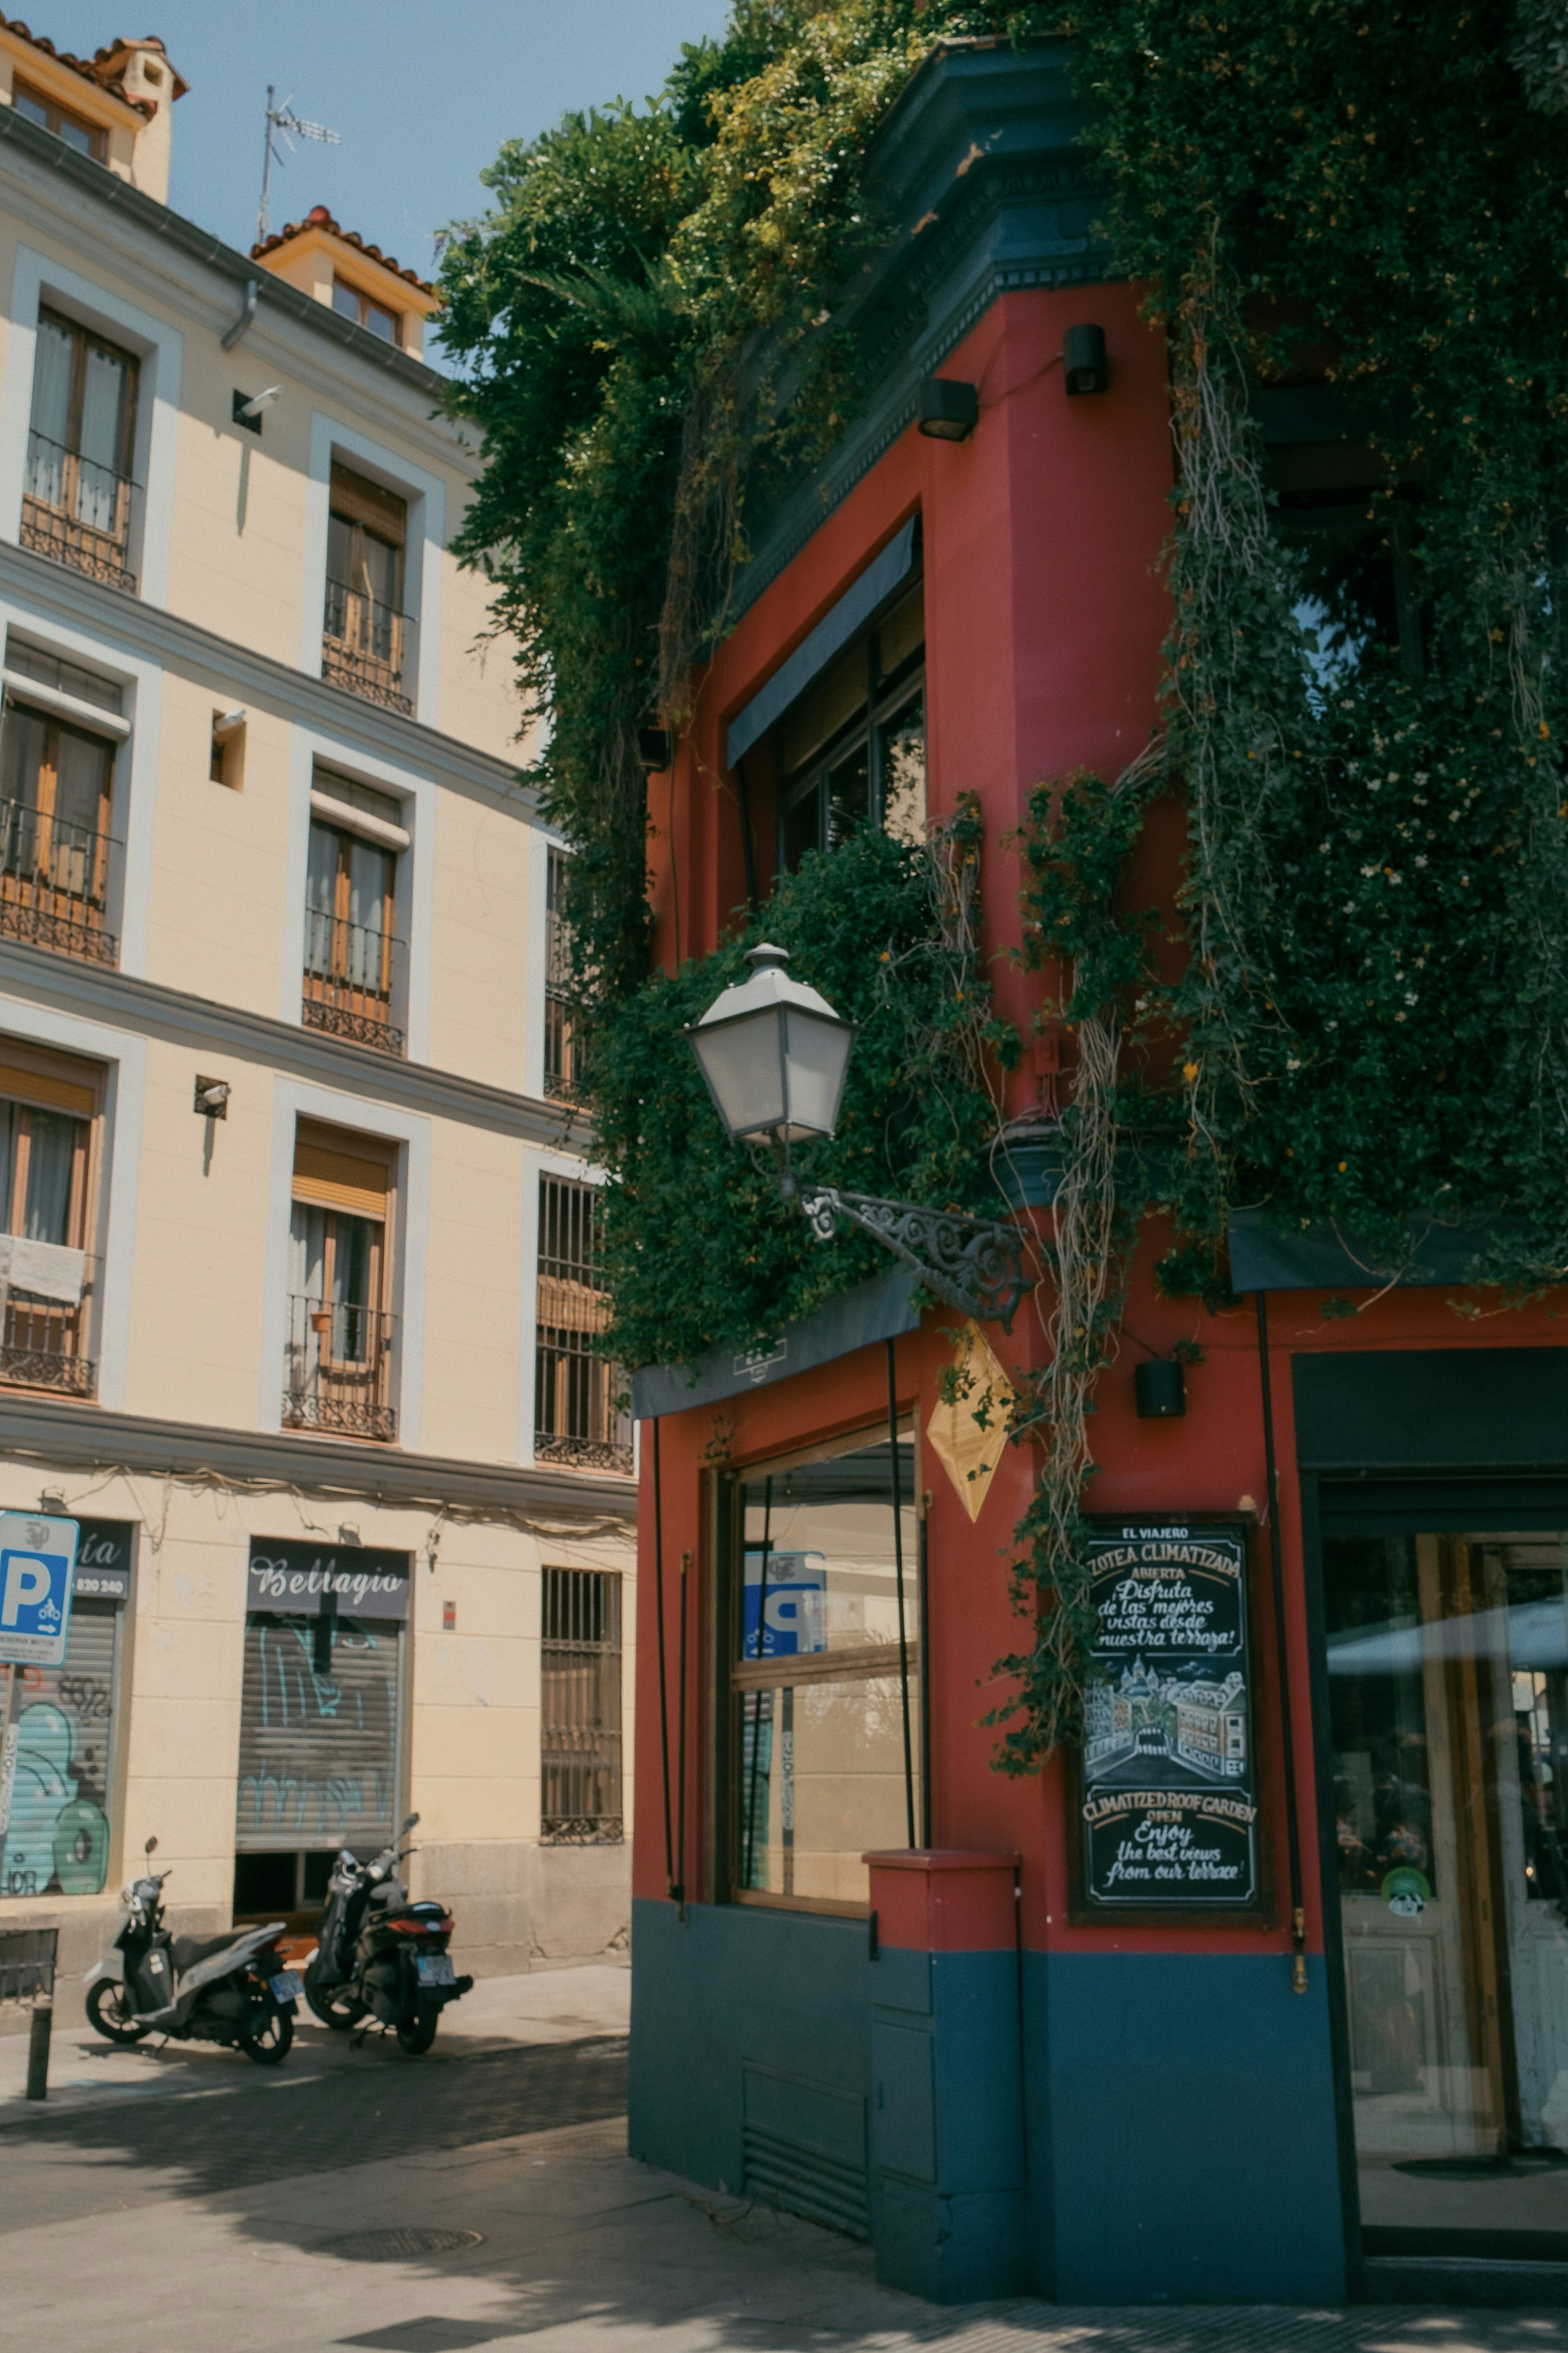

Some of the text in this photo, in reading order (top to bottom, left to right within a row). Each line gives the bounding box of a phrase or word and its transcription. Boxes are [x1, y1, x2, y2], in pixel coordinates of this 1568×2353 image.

[1122, 1527, 1189, 1539] EL VIAJERO
[1086, 1543, 1241, 1579] ZOTEA CLIMATIZADA
[1131, 1566, 1186, 1579] ABIERTA
[1, 1556, 51, 1626] P
[250, 1556, 403, 1605] Bellagio
[1098, 1598, 1214, 1618] de las mejores
[1107, 1613, 1208, 1630] vistas desde
[1099, 1628, 1235, 1652] nuestra terraza!
[1082, 1792, 1257, 1823] CLIMATIZED ROOF GARDEN
[1147, 1810, 1182, 1823] OPEN
[1134, 1820, 1194, 1847] Enjoy
[1116, 1840, 1222, 1862] the best views
[1102, 1860, 1152, 1888] from
[1155, 1863, 1186, 1880] our
